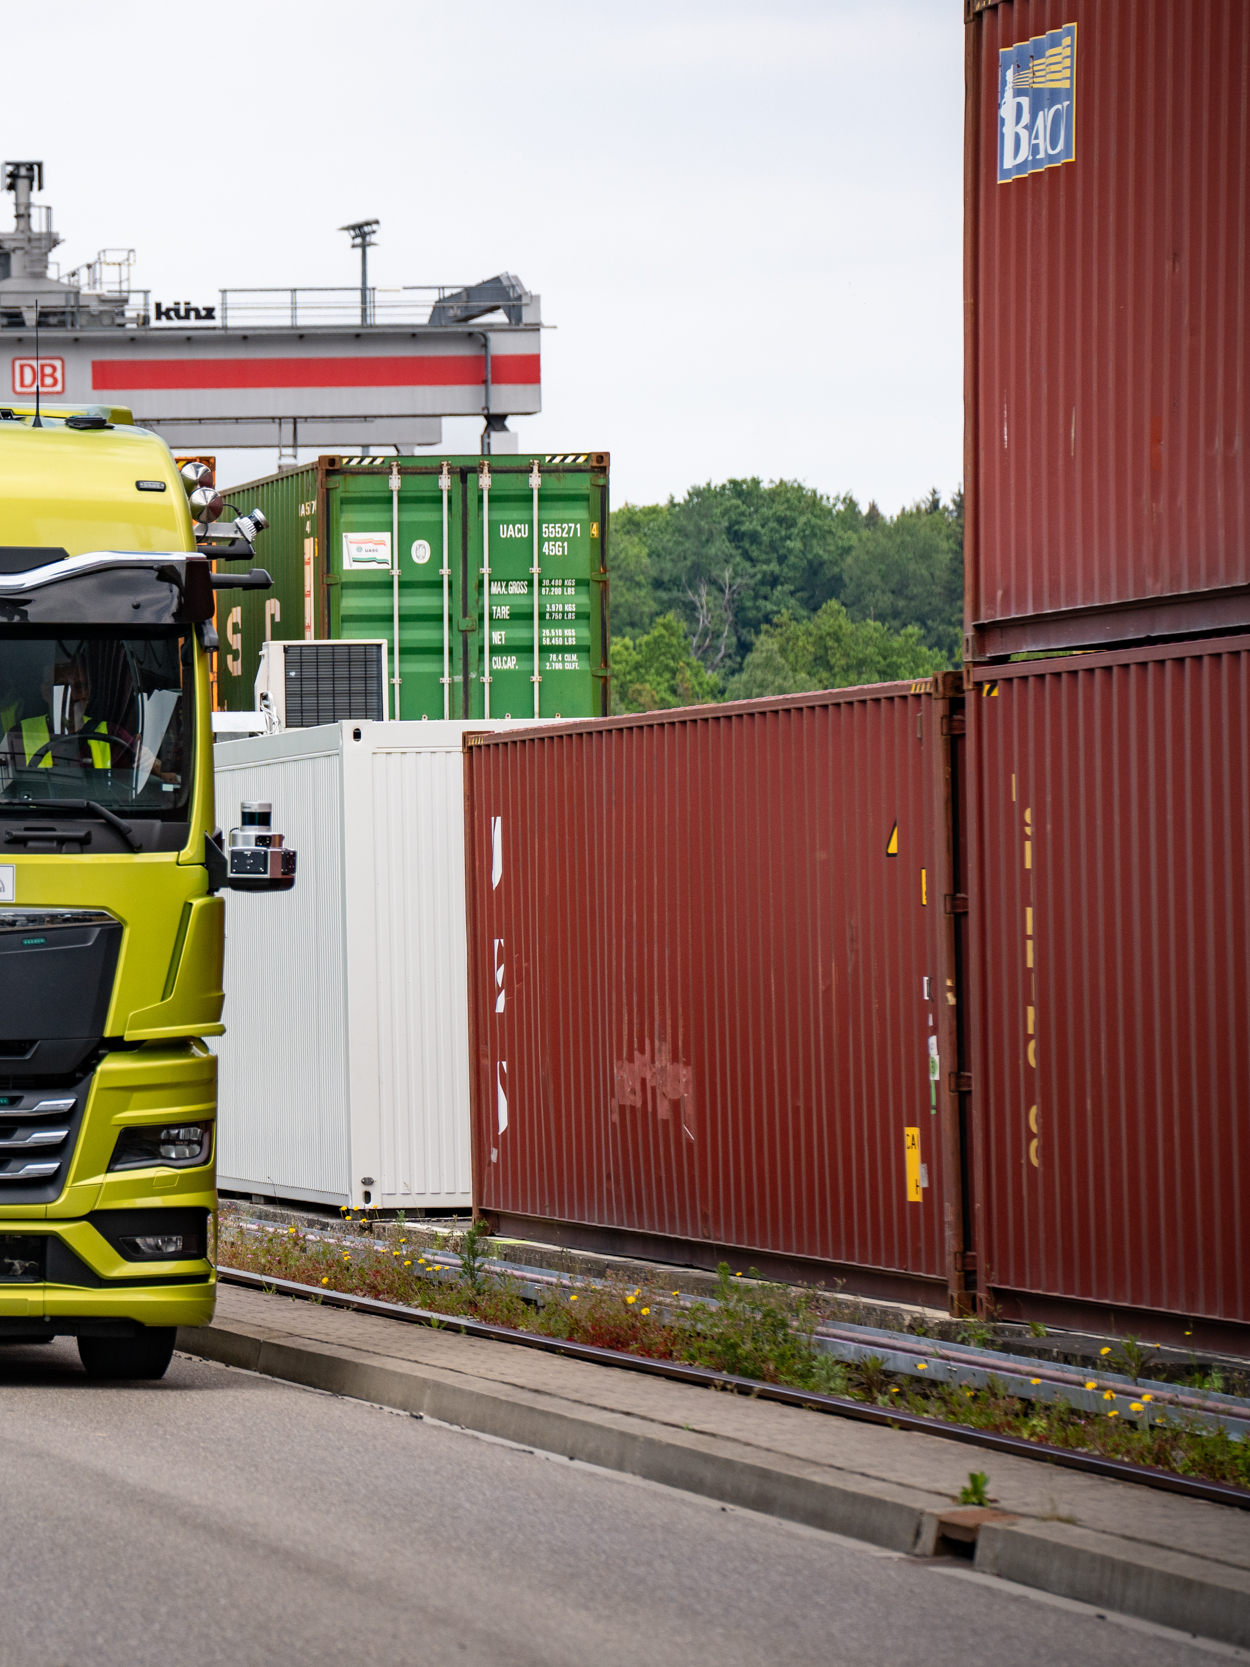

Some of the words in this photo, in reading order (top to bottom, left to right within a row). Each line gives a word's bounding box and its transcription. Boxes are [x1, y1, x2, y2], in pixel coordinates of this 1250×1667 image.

[155, 301, 216, 321] künz
[18, 363, 59, 389] DB
[499, 523, 529, 538] UACU
[542, 523, 581, 538] 555271
[590, 522, 599, 538] 4
[542, 541, 568, 556] 45G1
[490, 581, 508, 595] MAX.
[508, 580, 528, 594] GROSS
[563, 587, 576, 595] LBS
[492, 605, 510, 619] TARE
[545, 603, 563, 611] 3.970
[564, 603, 576, 611] KGS
[564, 612, 576, 620] LBS
[491, 631, 506, 645] NET
[564, 637, 576, 645] LBS
[492, 656, 519, 669] CU.CAP.
